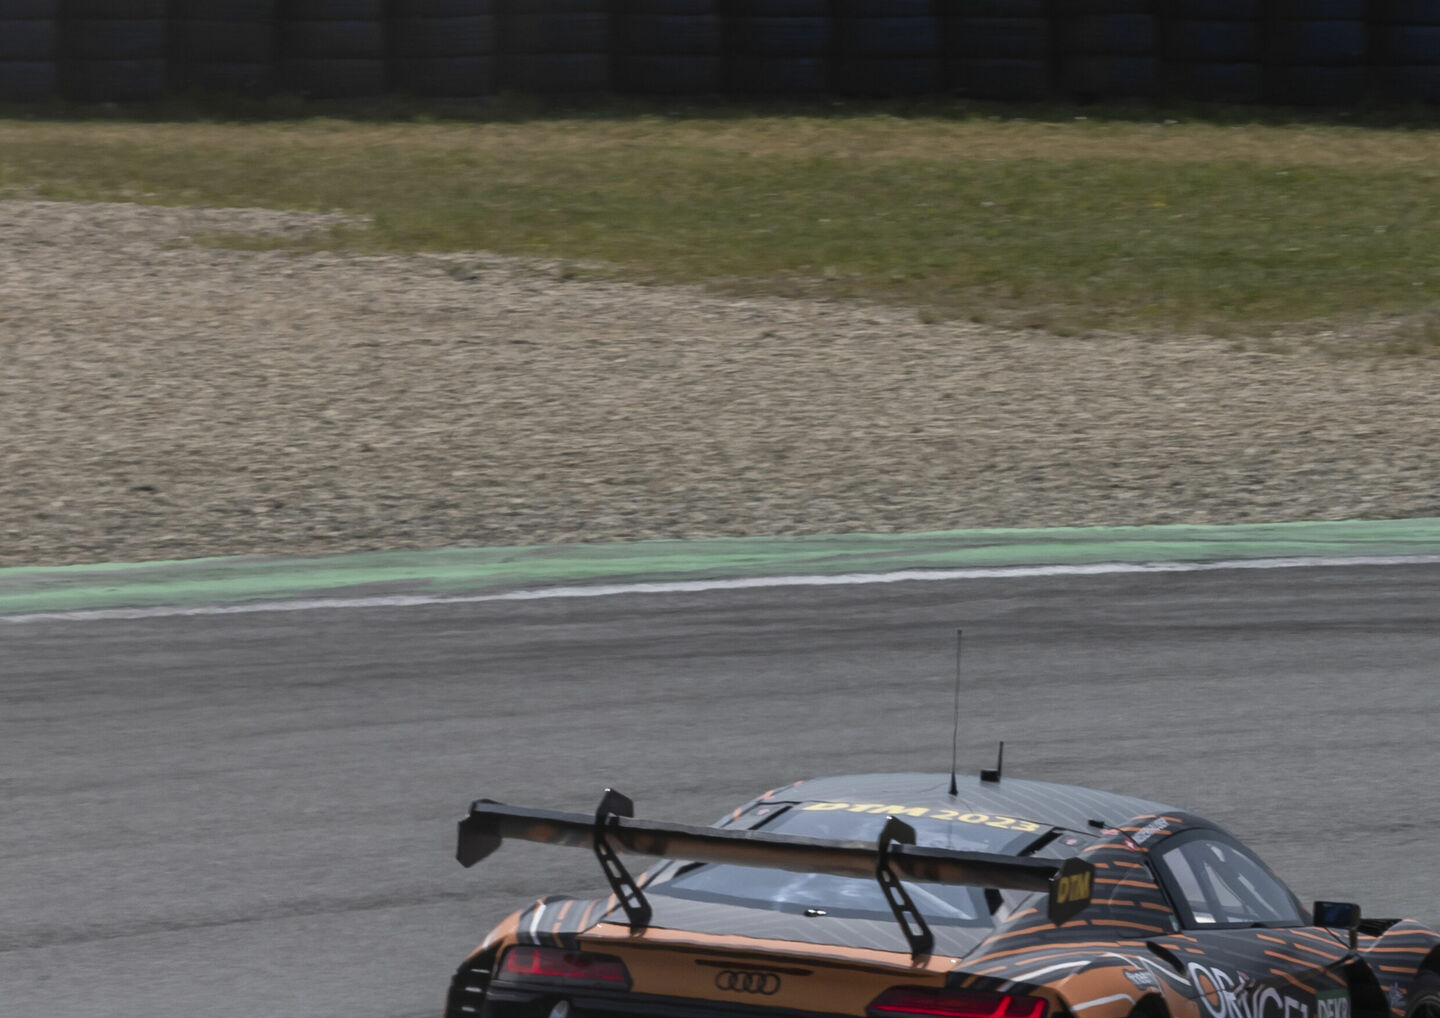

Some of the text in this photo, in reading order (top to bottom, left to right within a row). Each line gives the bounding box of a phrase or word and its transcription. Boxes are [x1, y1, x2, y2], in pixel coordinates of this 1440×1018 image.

[801, 802, 1040, 832] DTM 2023
[1057, 871, 1091, 904] DTM
